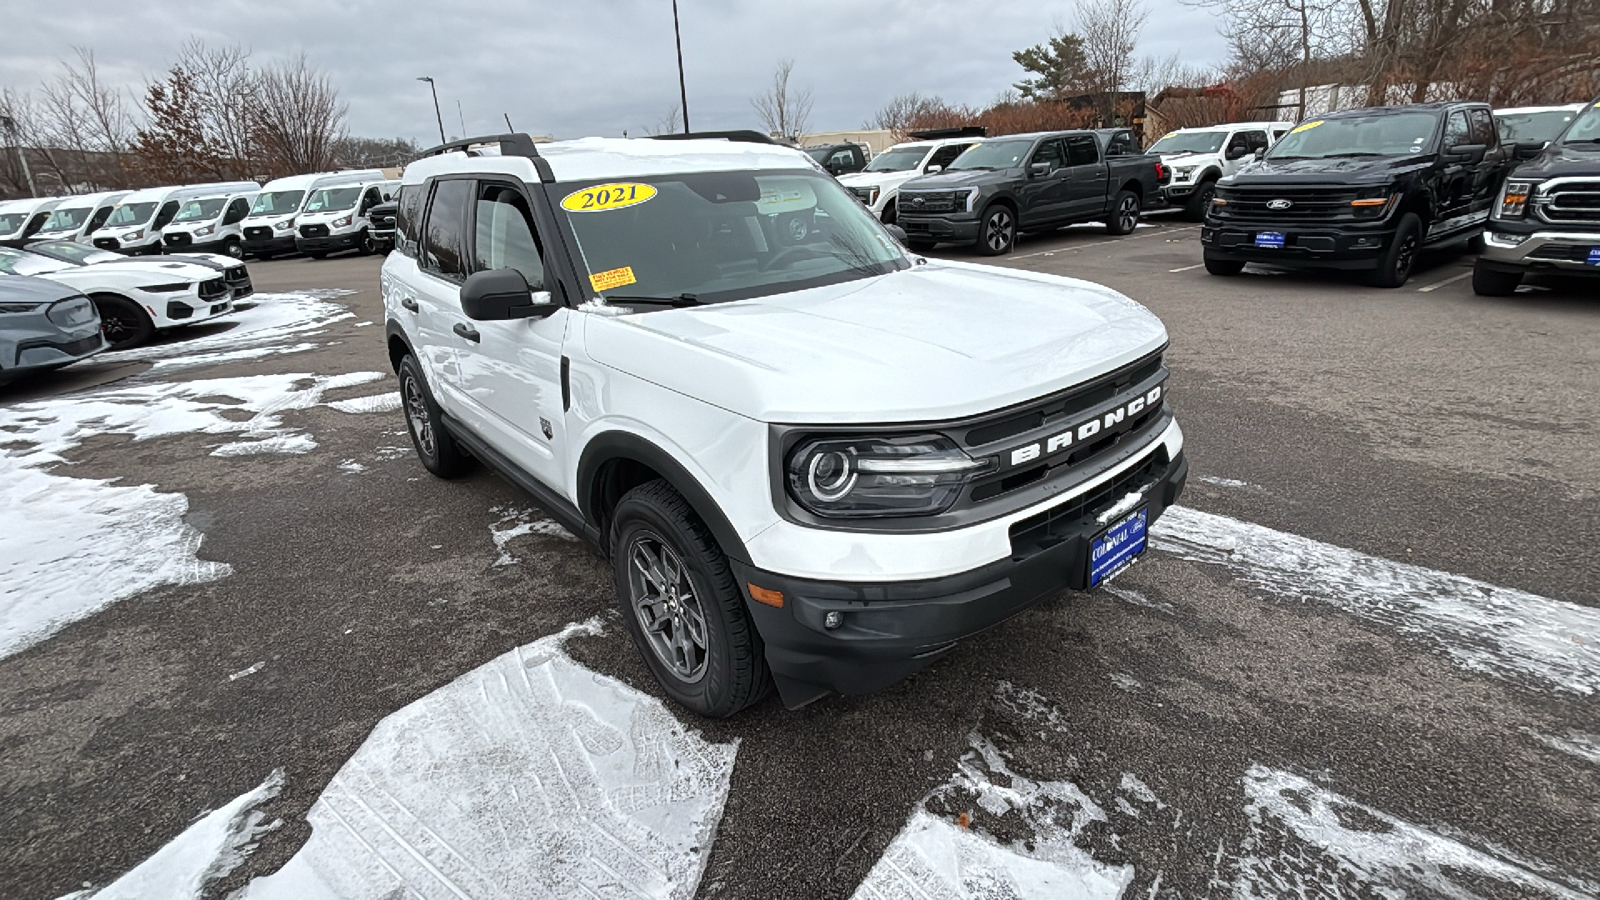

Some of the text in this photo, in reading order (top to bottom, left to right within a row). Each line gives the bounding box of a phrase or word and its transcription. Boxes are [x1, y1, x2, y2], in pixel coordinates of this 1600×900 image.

[581, 185, 637, 208] 2021
[1011, 386, 1161, 466] BRONCO
[1092, 528, 1129, 562] COLNIAL
